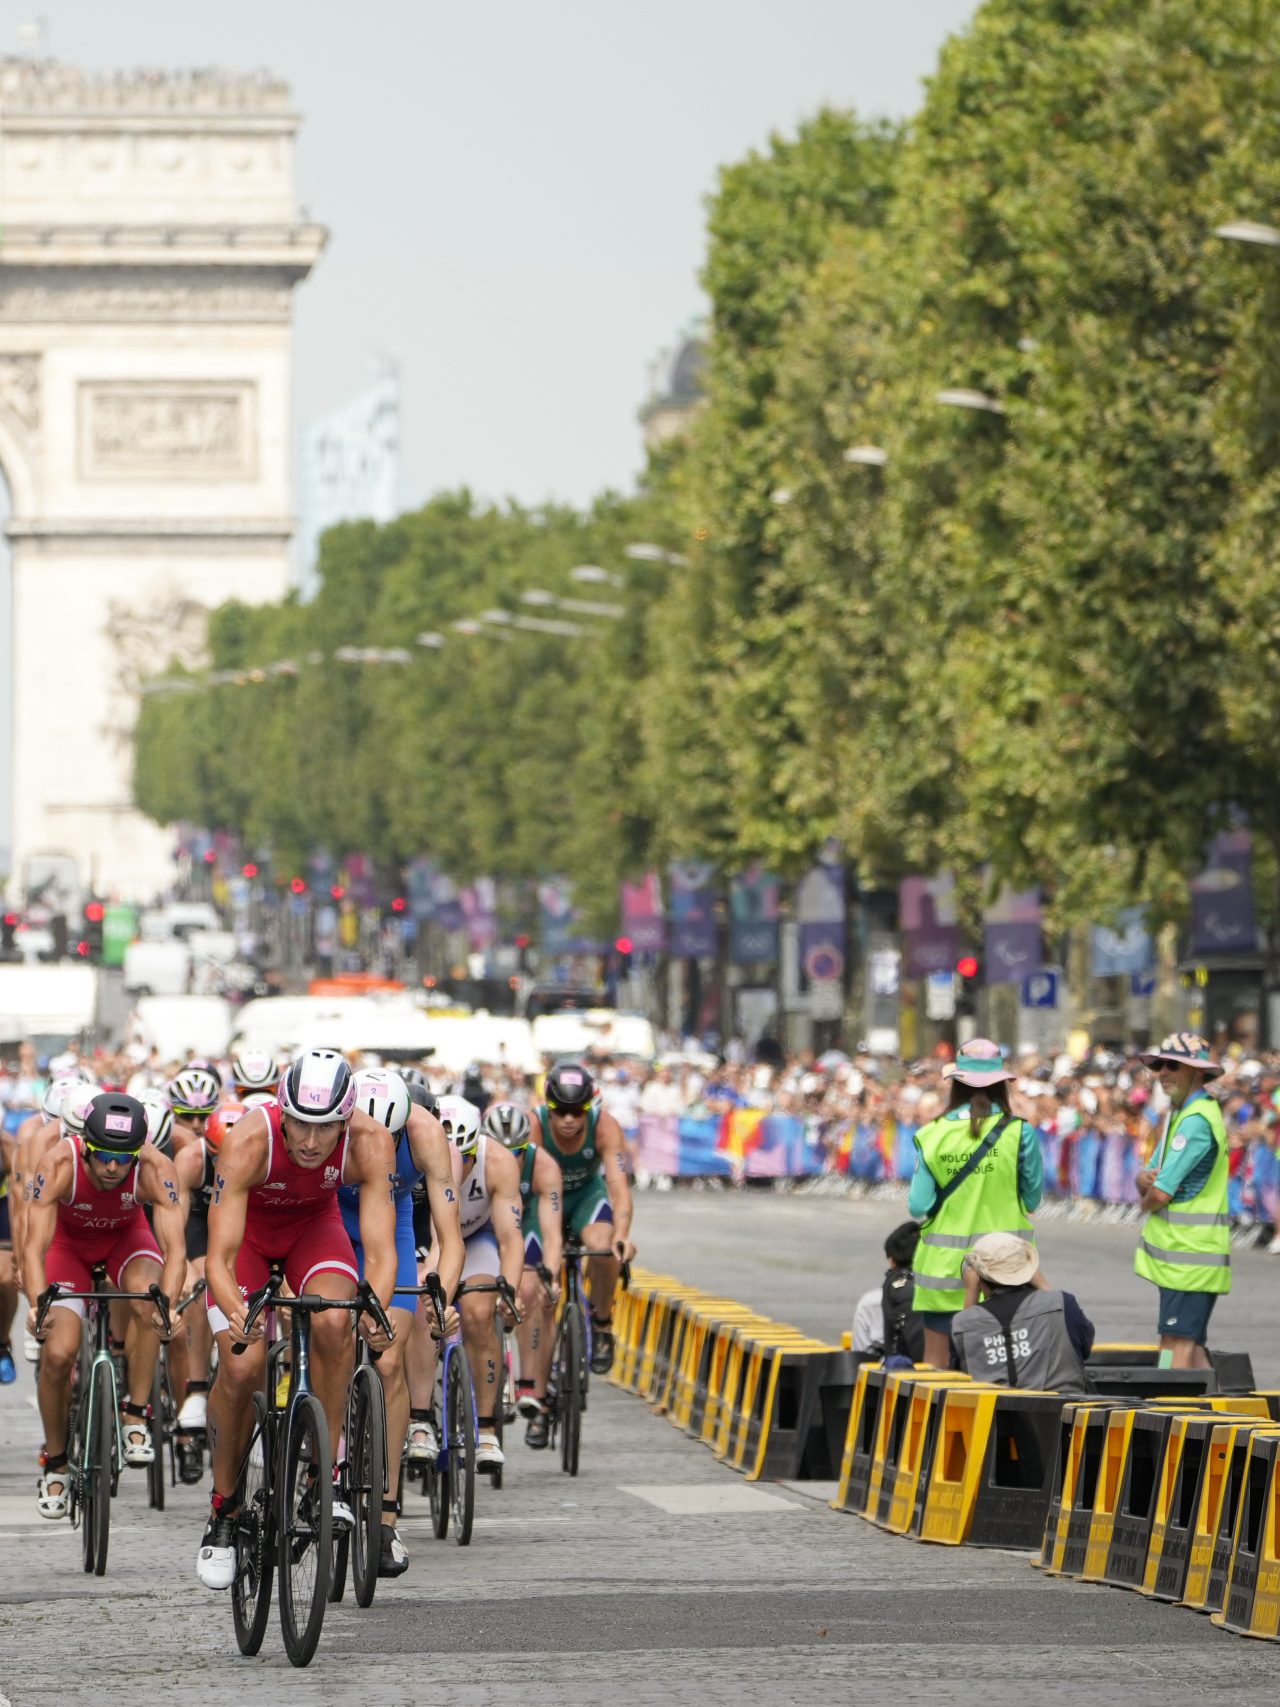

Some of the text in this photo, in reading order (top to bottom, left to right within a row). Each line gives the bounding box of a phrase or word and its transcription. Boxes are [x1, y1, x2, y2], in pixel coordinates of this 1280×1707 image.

[33, 1174, 46, 1200] 42
[216, 1174, 225, 1204] 41
[444, 1187, 455, 1202] 2
[550, 1191, 560, 1212] 33
[985, 1340, 1032, 1366] 3998
